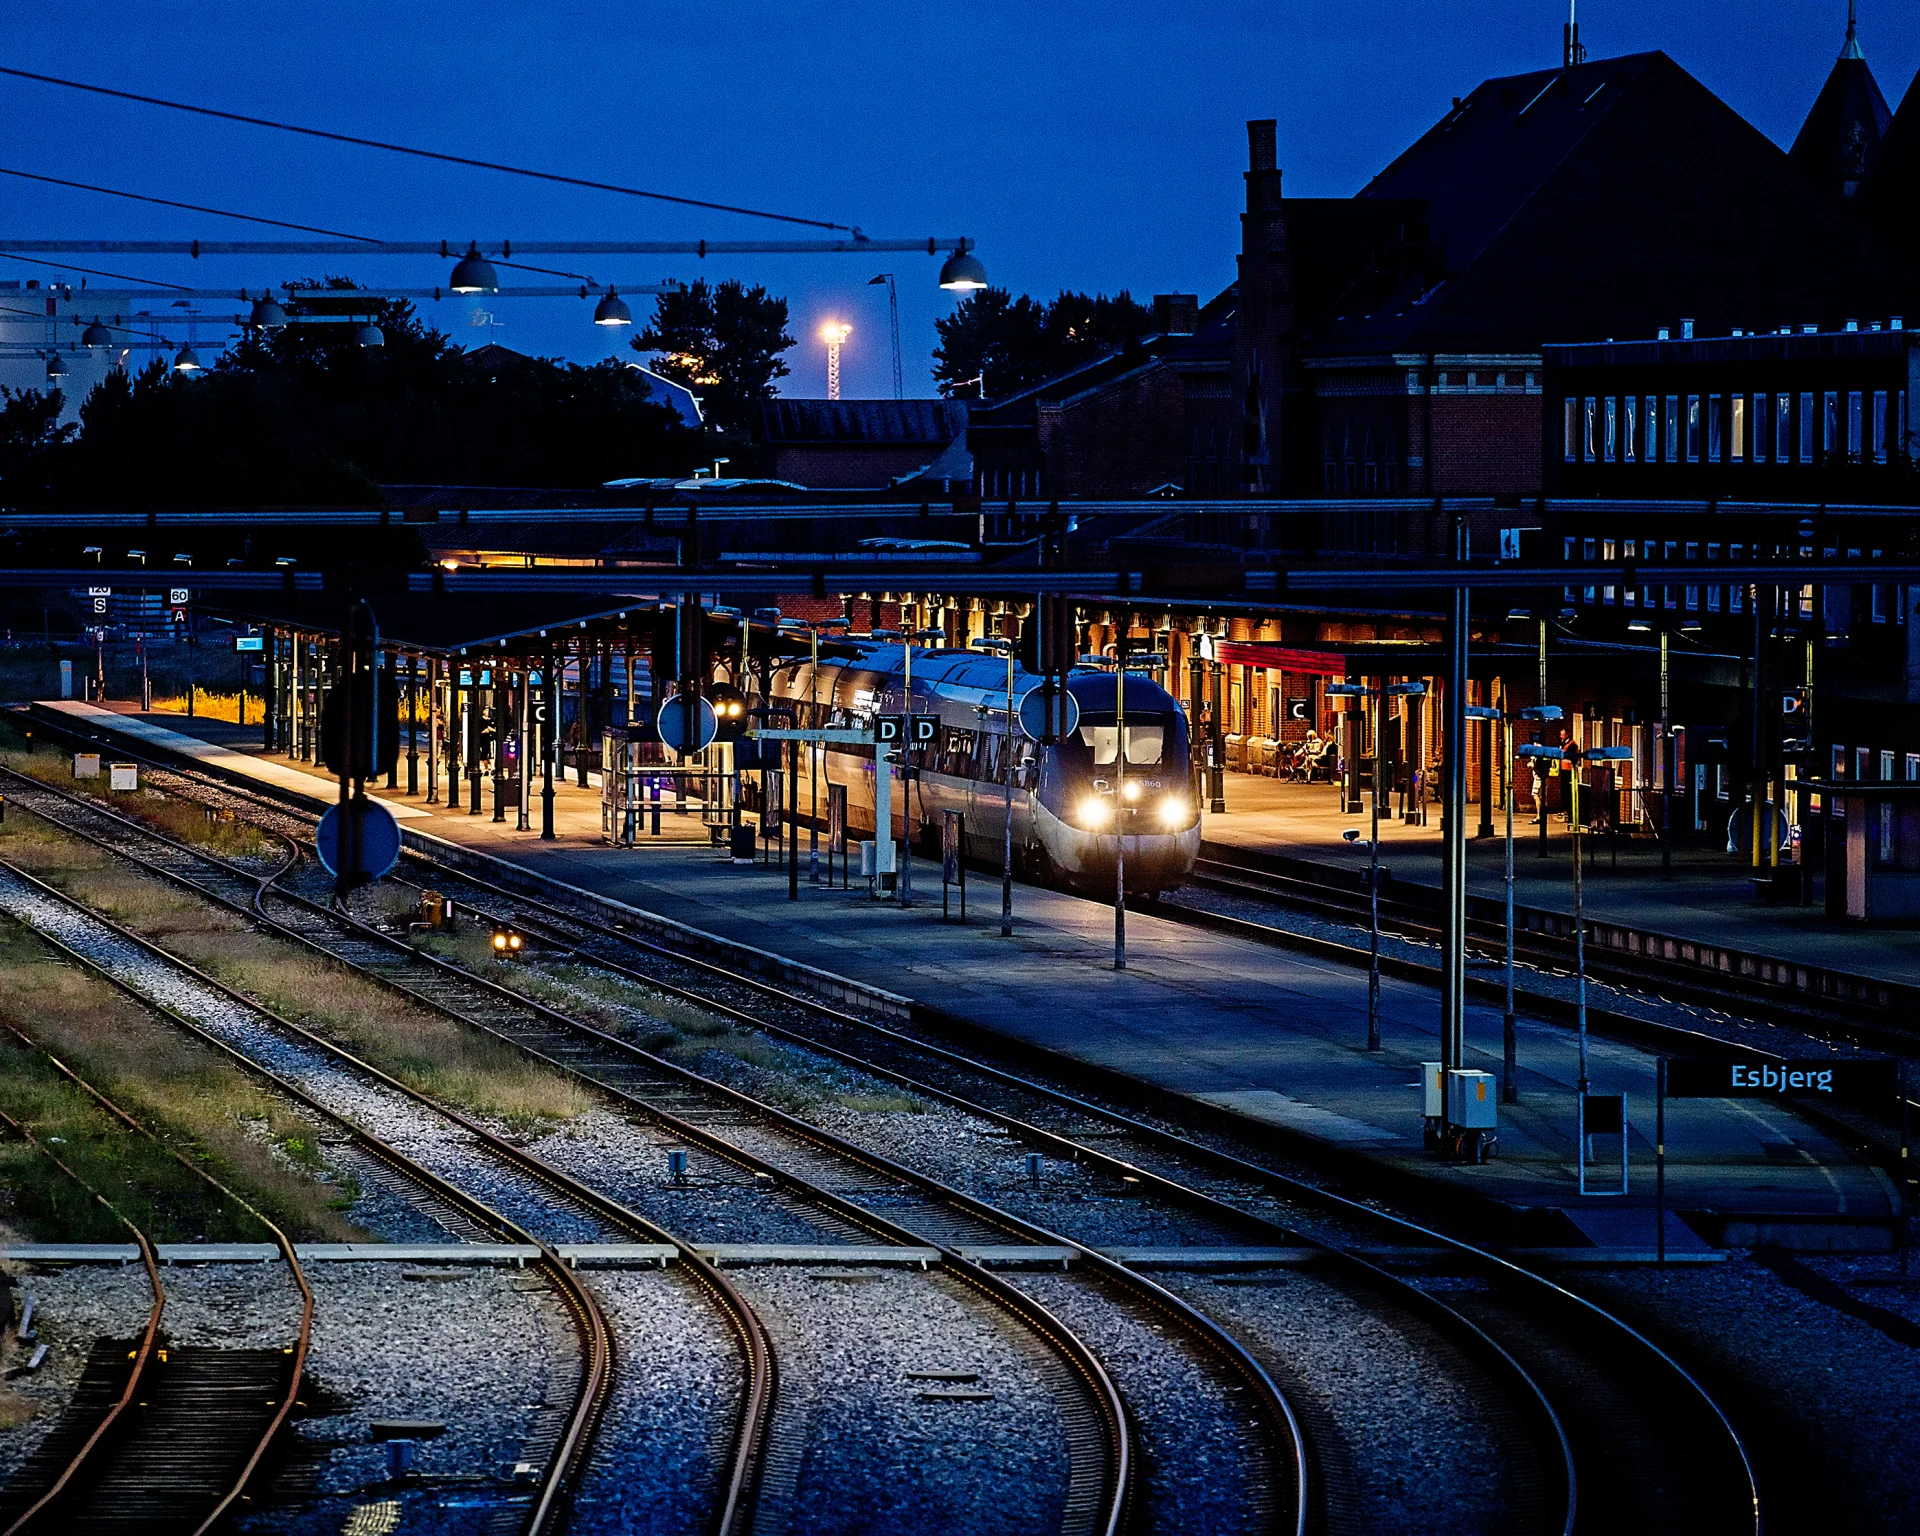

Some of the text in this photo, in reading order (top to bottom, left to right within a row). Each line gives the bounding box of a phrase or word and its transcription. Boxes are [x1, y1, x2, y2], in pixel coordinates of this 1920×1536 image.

[172, 590, 187, 601] 60
[95, 599, 105, 612] S
[174, 610, 185, 621] A
[1292, 703, 1305, 718] C
[1782, 696, 1798, 713] D
[535, 706, 546, 721] C
[881, 721, 897, 739] D
[918, 721, 934, 739] D
[1731, 1064, 1833, 1093] Esbjerg
